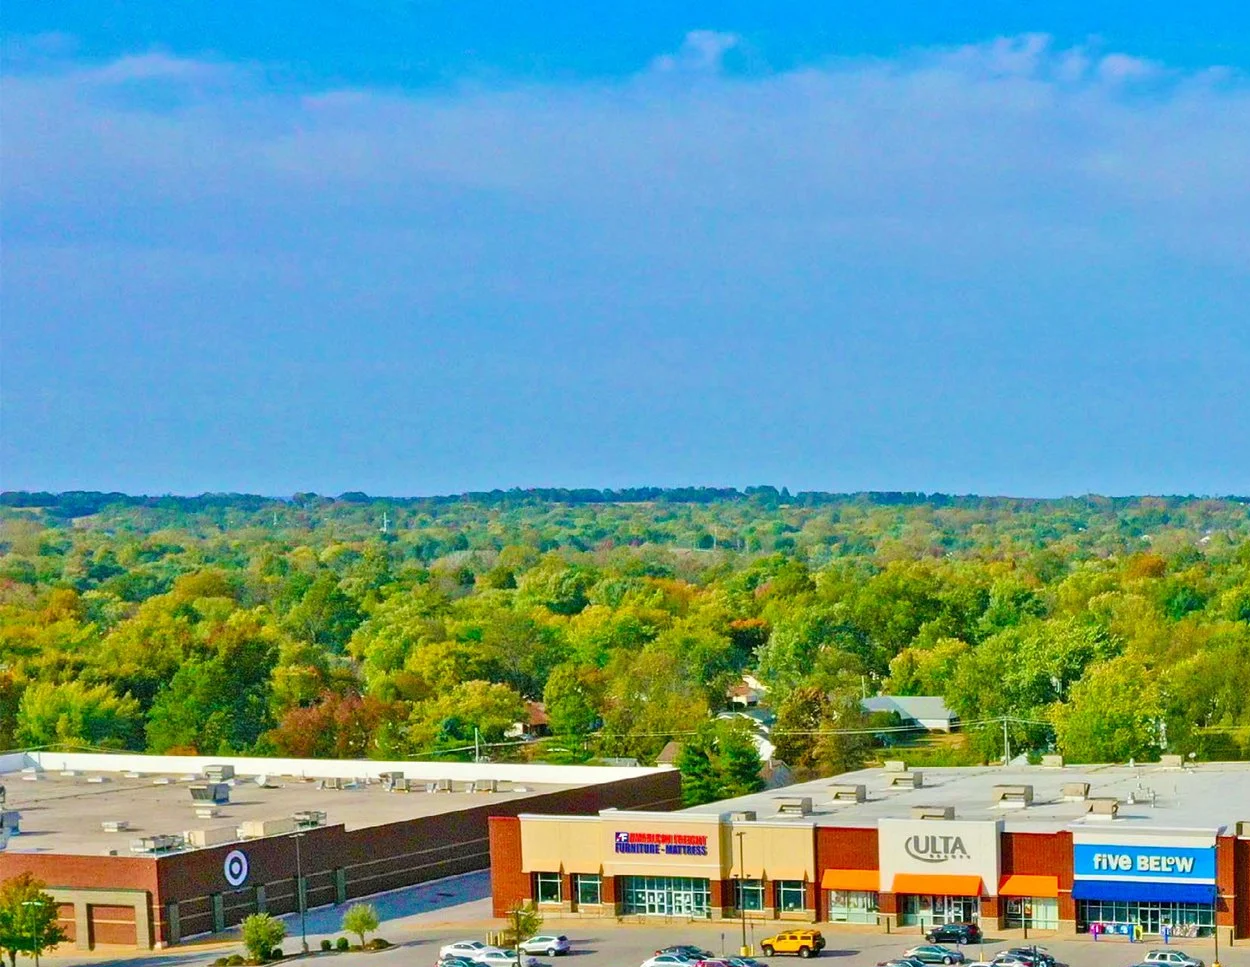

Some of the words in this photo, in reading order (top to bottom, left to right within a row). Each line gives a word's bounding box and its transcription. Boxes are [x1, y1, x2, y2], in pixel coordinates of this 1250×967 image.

[615, 843, 660, 854] FURNITURE
[665, 845, 707, 856] MATTRESS
[912, 835, 968, 855] ULTA
